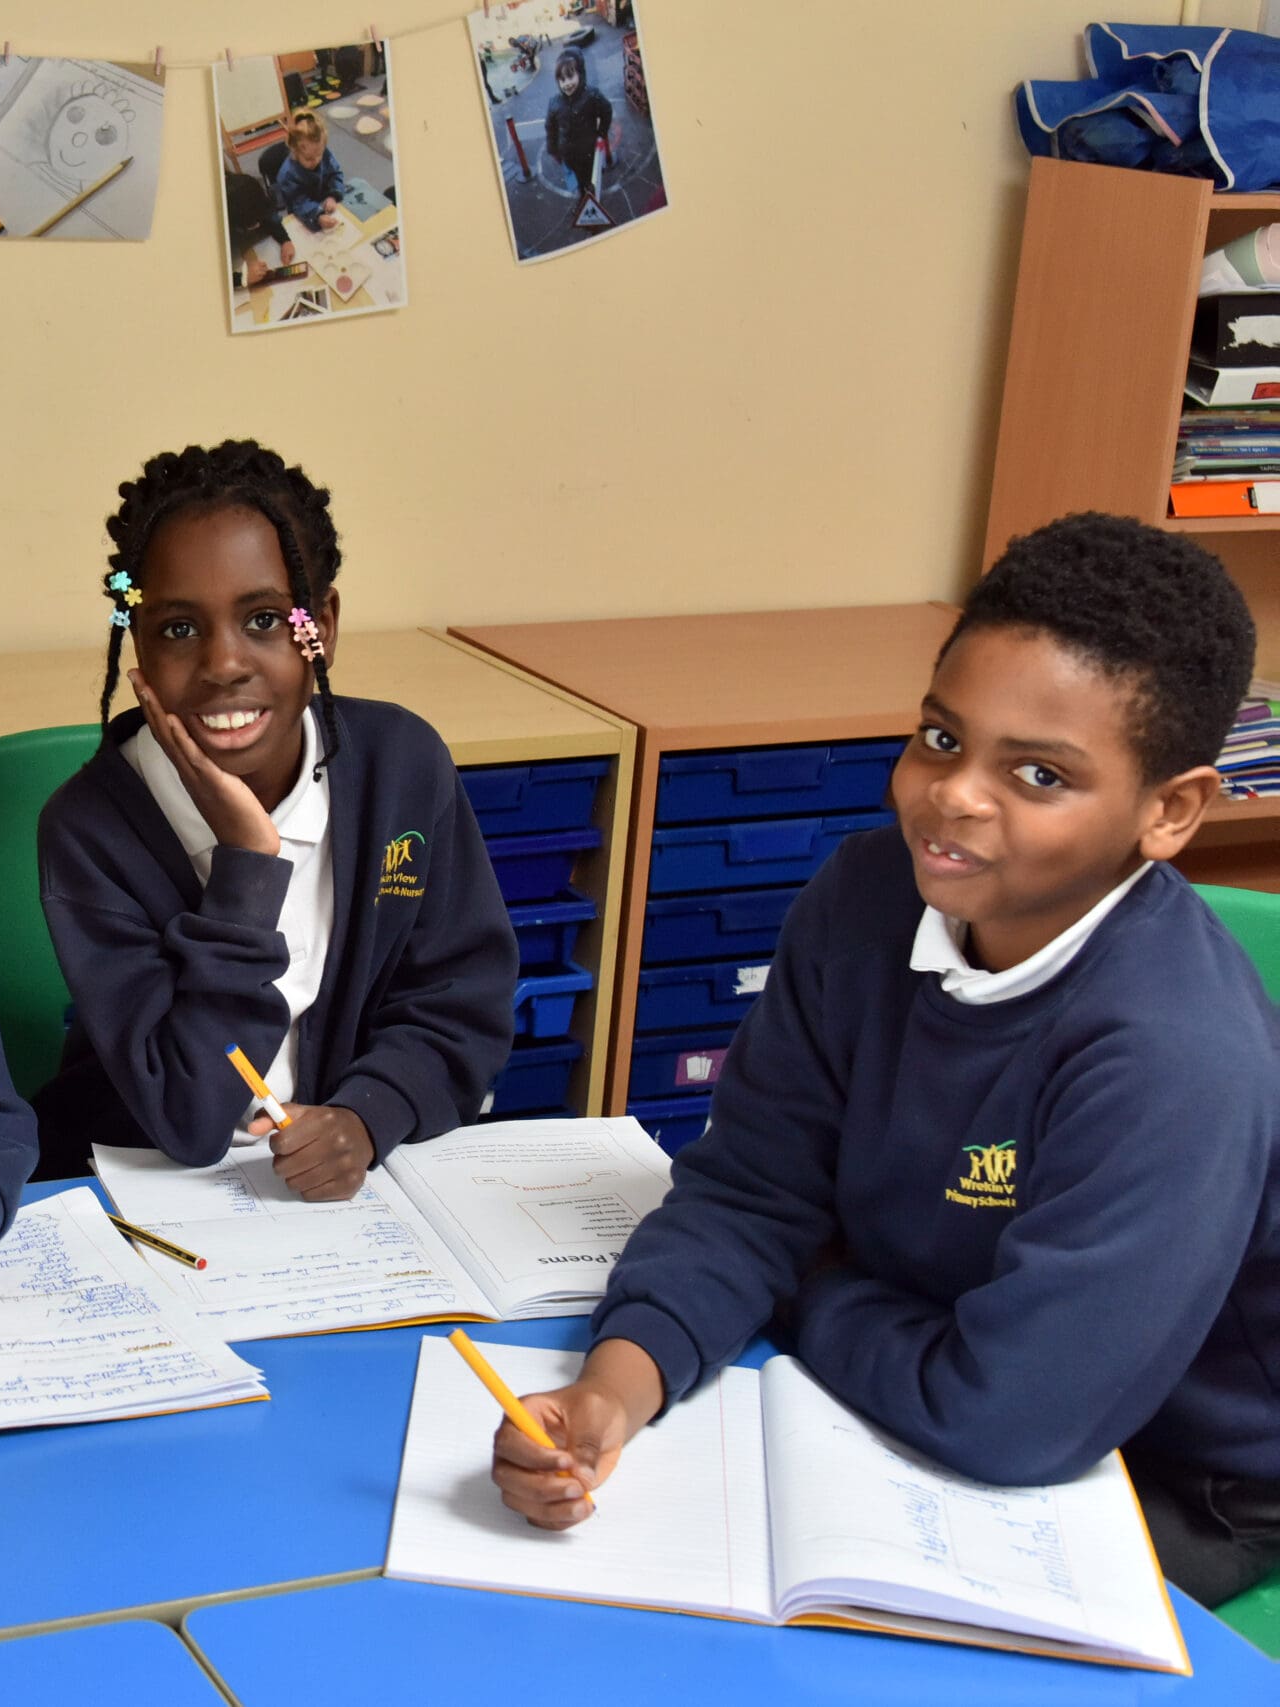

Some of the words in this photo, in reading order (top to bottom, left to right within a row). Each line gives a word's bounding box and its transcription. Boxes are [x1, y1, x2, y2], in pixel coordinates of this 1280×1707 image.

[393, 872, 418, 884] View
[959, 1176, 1004, 1193] Wrekin
[537, 1254, 609, 1265] Poems
